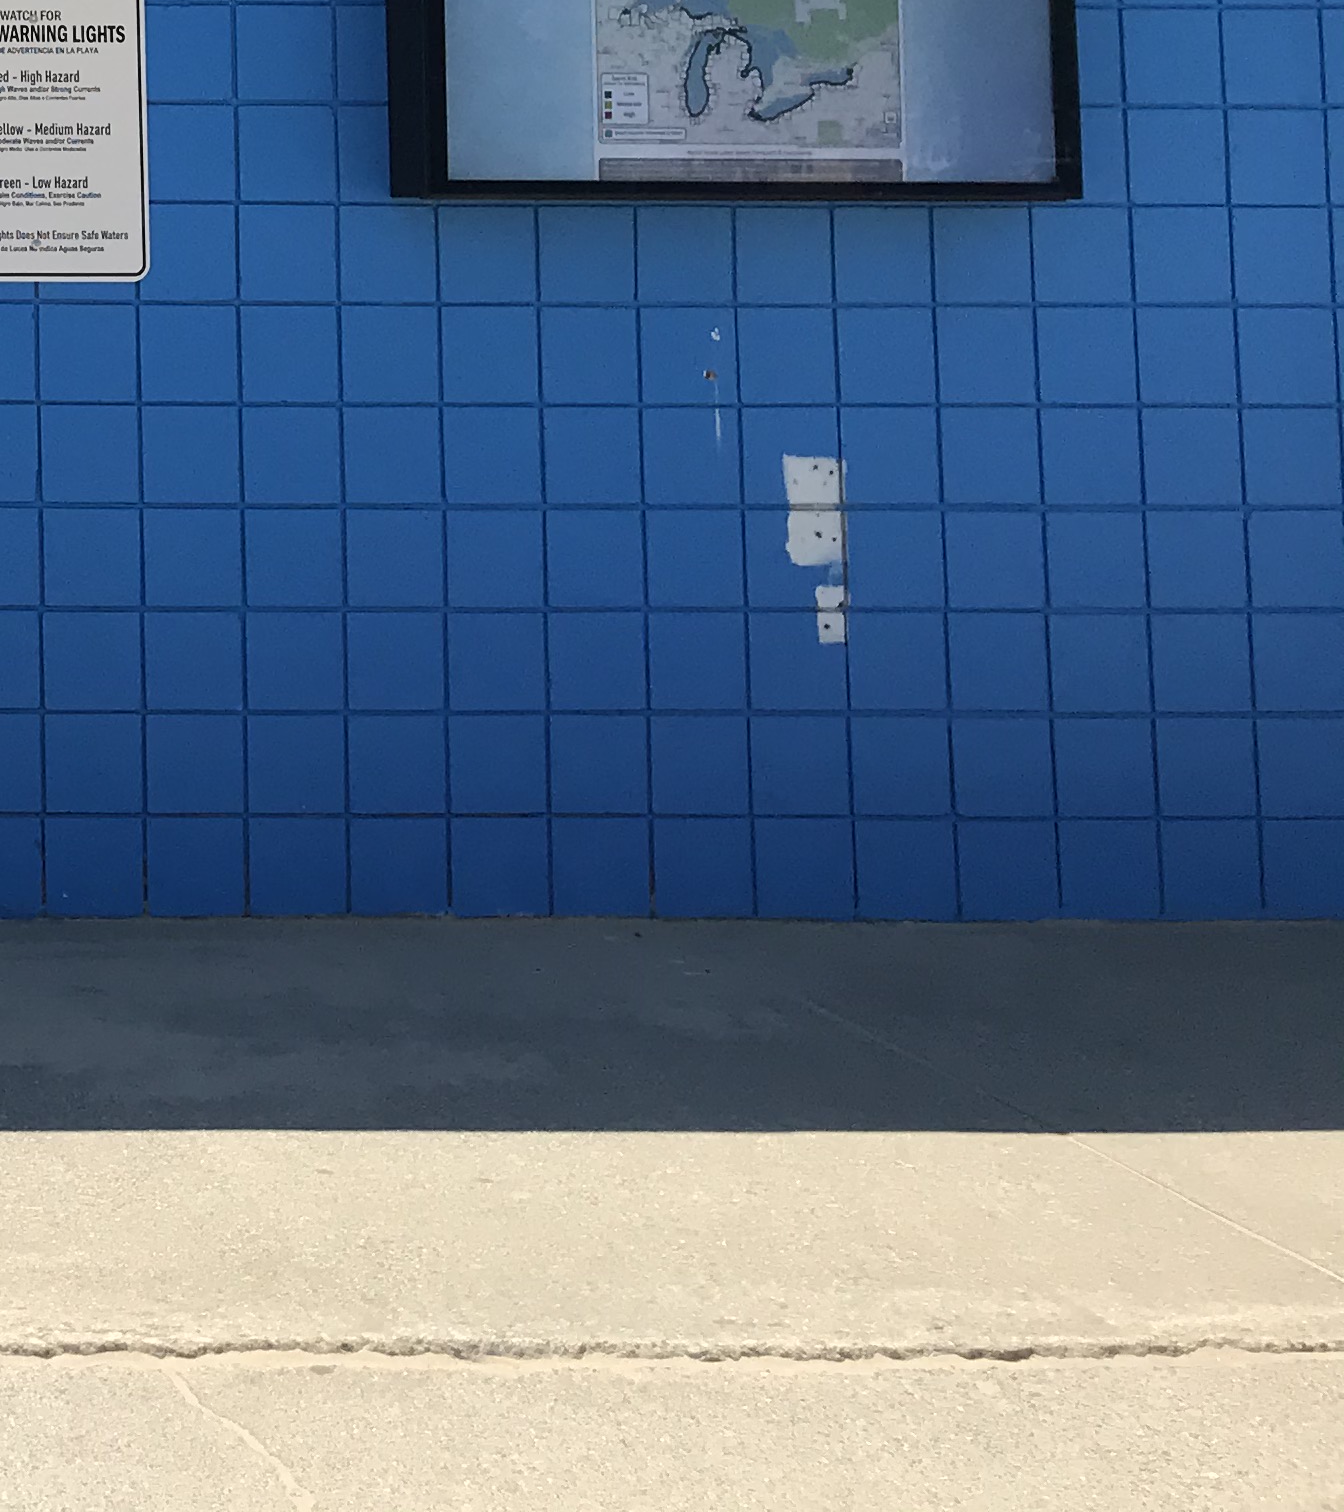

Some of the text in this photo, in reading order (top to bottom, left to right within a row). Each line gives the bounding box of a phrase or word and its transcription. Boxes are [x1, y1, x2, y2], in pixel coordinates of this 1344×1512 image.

[0, 10, 62, 21] WATCH FOR
[72, 25, 126, 43] LIGHTS
[76, 47, 99, 55] PLAYA
[20, 70, 42, 85] High
[45, 70, 80, 83] Hazard
[35, 123, 74, 136] Medium
[77, 123, 111, 136] Hazard
[32, 176, 52, 189] Low
[54, 176, 89, 189] Hazard
[16, 230, 35, 239] Does
[36, 230, 50, 239] Not
[52, 230, 79, 239] Ensure
[81, 231, 99, 239] Safe
[101, 231, 129, 240] Waters
